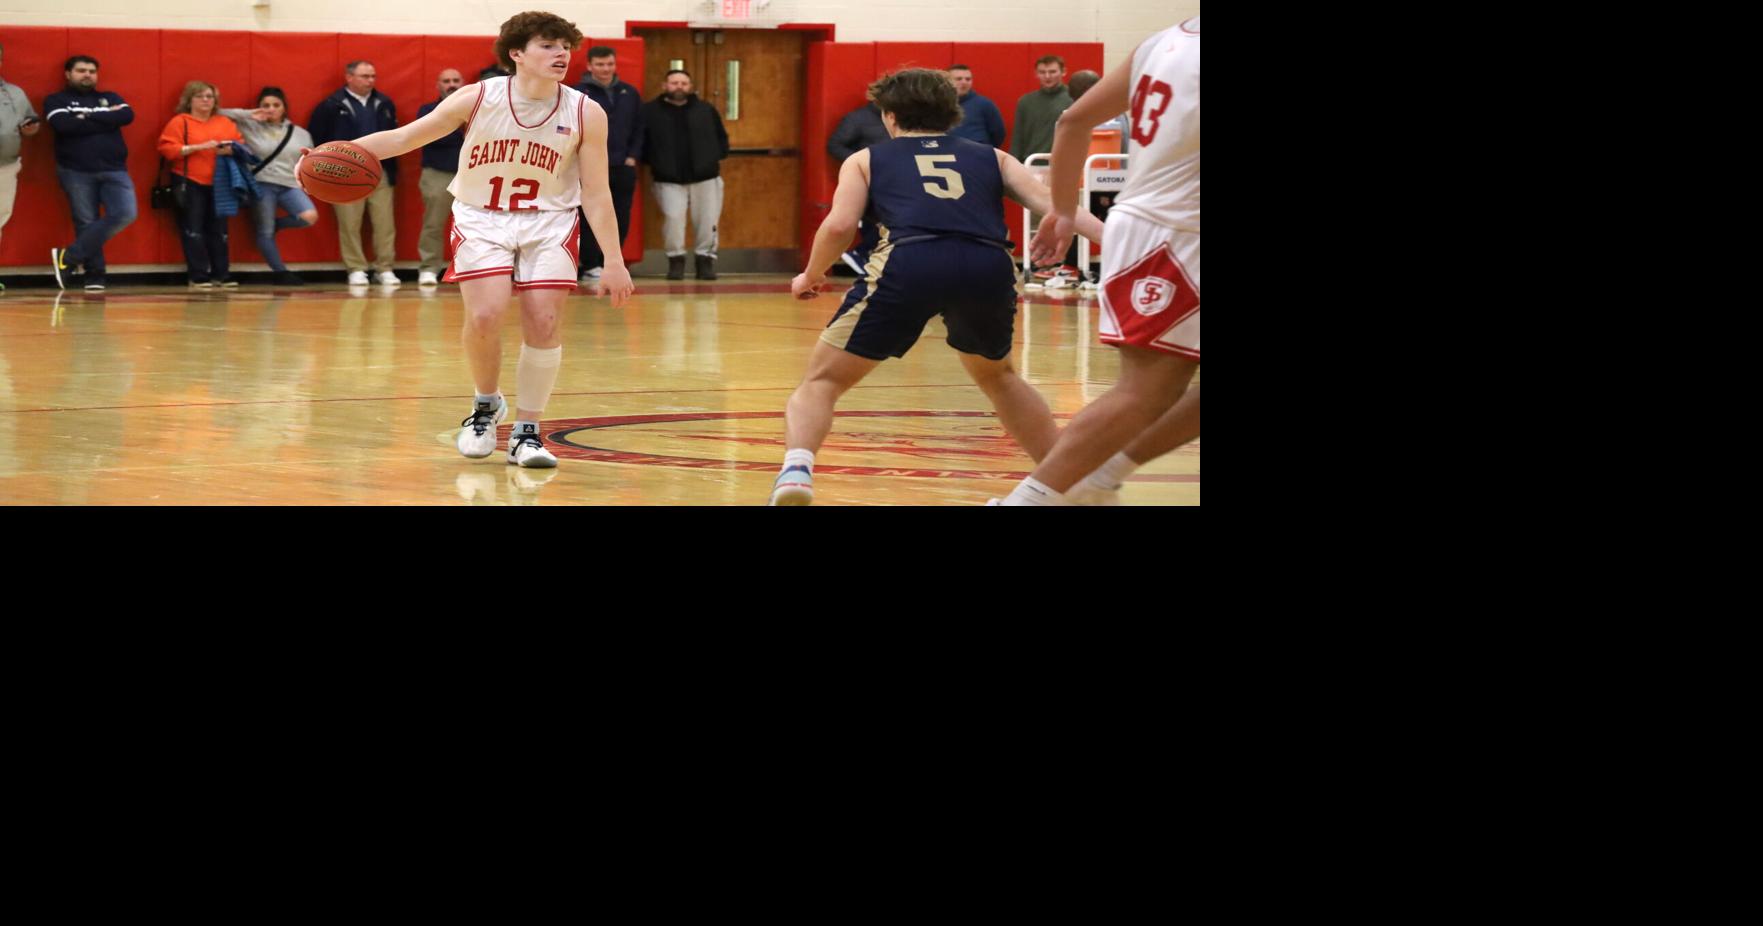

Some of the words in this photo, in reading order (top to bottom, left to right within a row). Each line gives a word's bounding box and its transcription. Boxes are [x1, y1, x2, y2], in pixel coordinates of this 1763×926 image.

[722, 0, 751, 17] EXIT
[468, 139, 520, 169] SAINT
[914, 154, 966, 200] 5
[483, 176, 541, 212] 12
